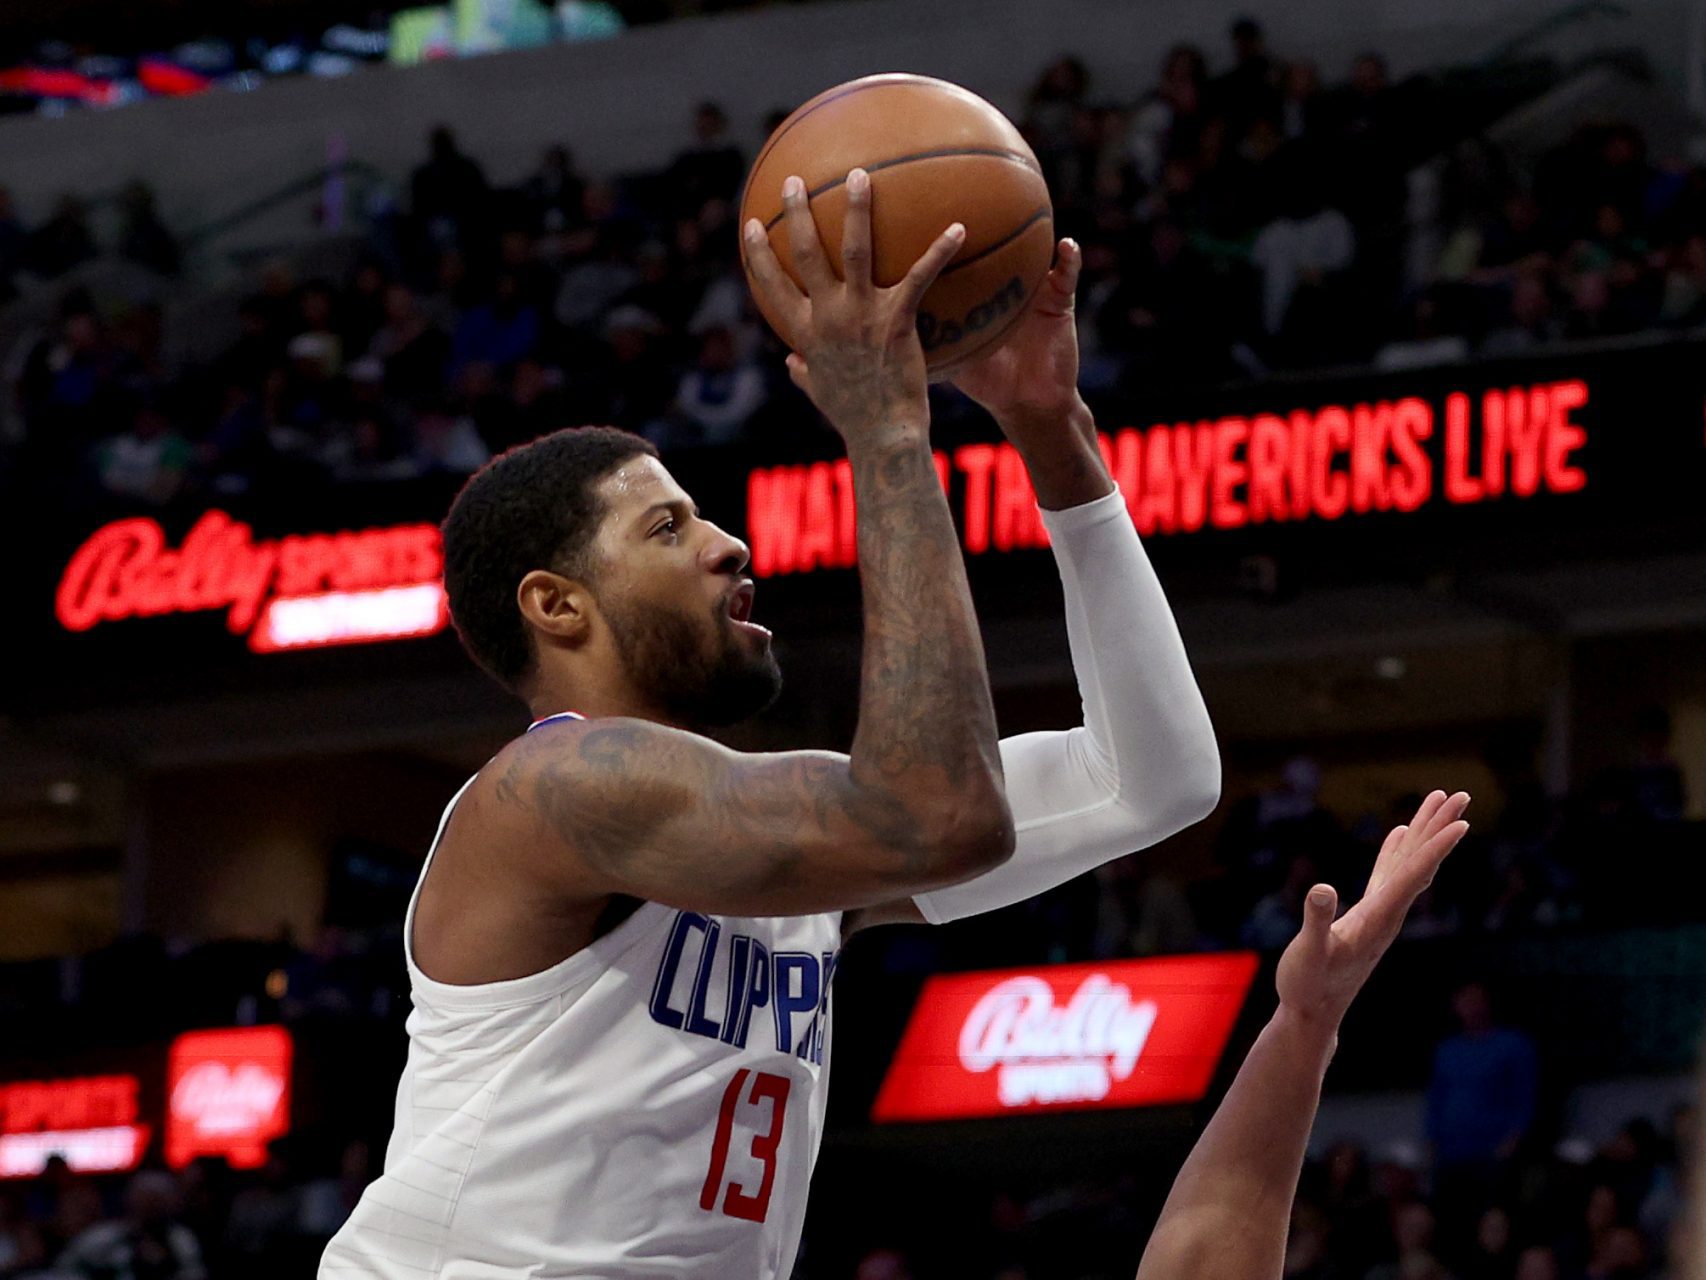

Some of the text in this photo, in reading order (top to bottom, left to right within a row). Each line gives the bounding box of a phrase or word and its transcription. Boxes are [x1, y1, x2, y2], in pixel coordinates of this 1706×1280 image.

[955, 440, 1052, 556] TH
[1445, 380, 1588, 503] LIVE
[56, 509, 276, 632] Bally
[649, 911, 834, 1066] CLIPP
[959, 973, 1158, 1080] Bally
[699, 1068, 791, 1224] 13
